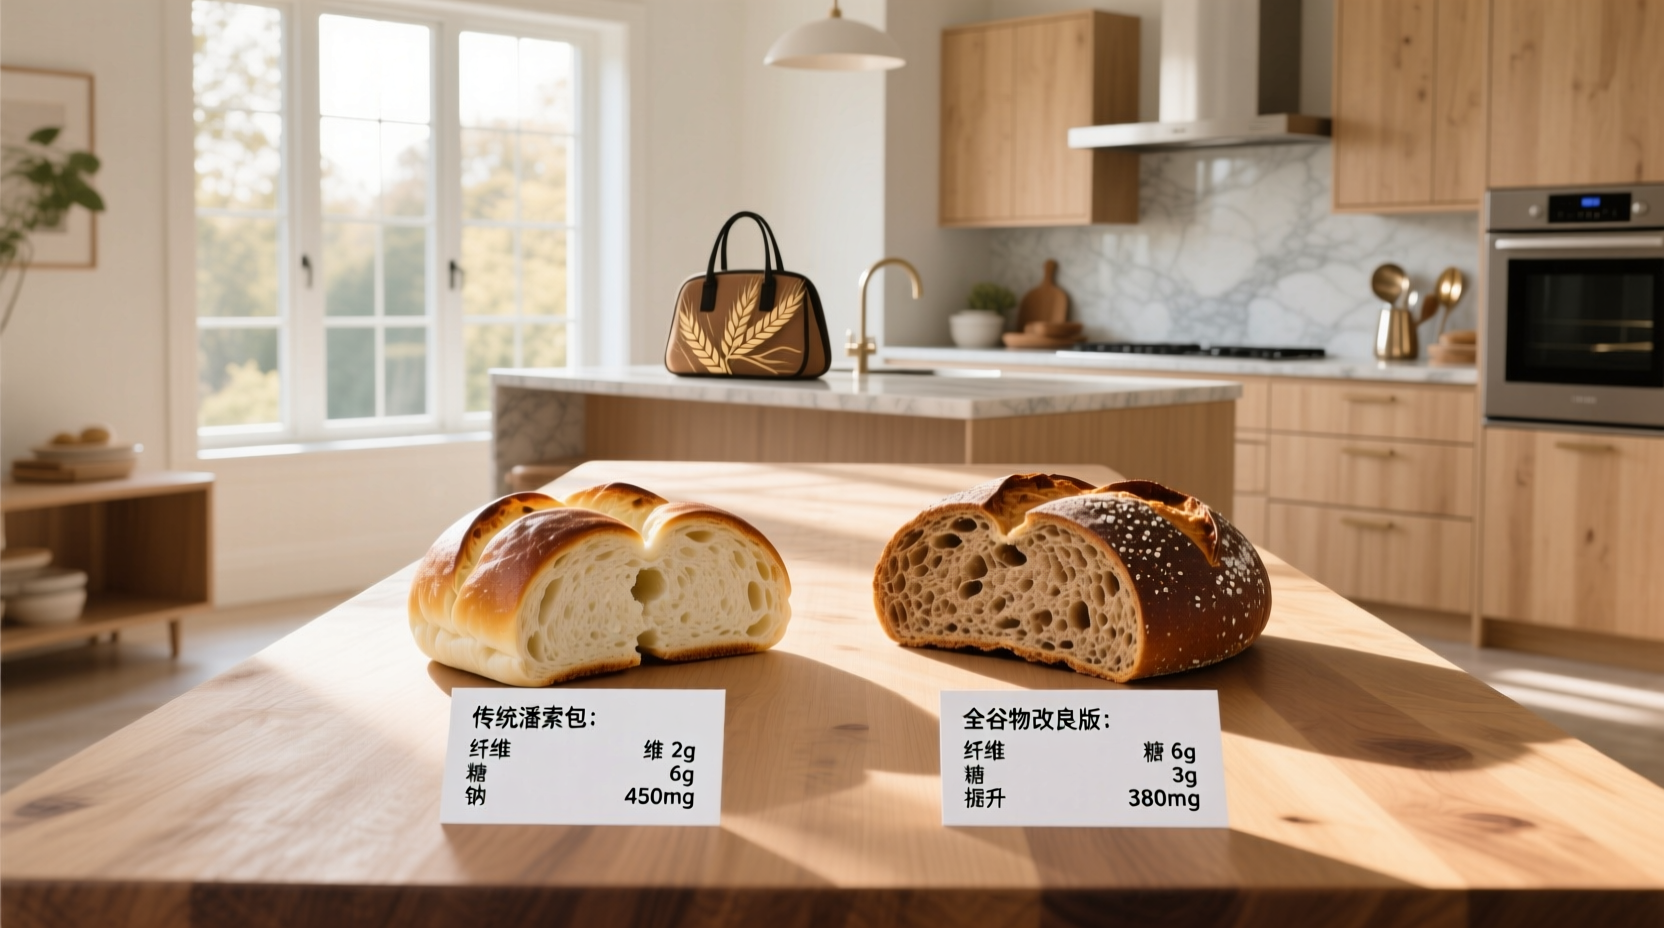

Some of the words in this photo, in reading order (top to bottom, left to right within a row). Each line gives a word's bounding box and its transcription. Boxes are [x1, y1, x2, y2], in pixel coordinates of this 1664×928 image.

[469, 738, 512, 760] 纤维
[643, 739, 664, 761] 维
[671, 741, 696, 764] 2g
[963, 739, 1006, 762] 纤维
[1142, 740, 1165, 763] 糖
[1171, 742, 1196, 765] 6g
[465, 762, 487, 783] 糖
[669, 764, 694, 787] 6g
[964, 764, 985, 785] 糖
[1172, 766, 1198, 789] 3g
[464, 783, 487, 806] 钠
[624, 787, 695, 810] 450mg
[1128, 788, 1200, 812] 380mg
